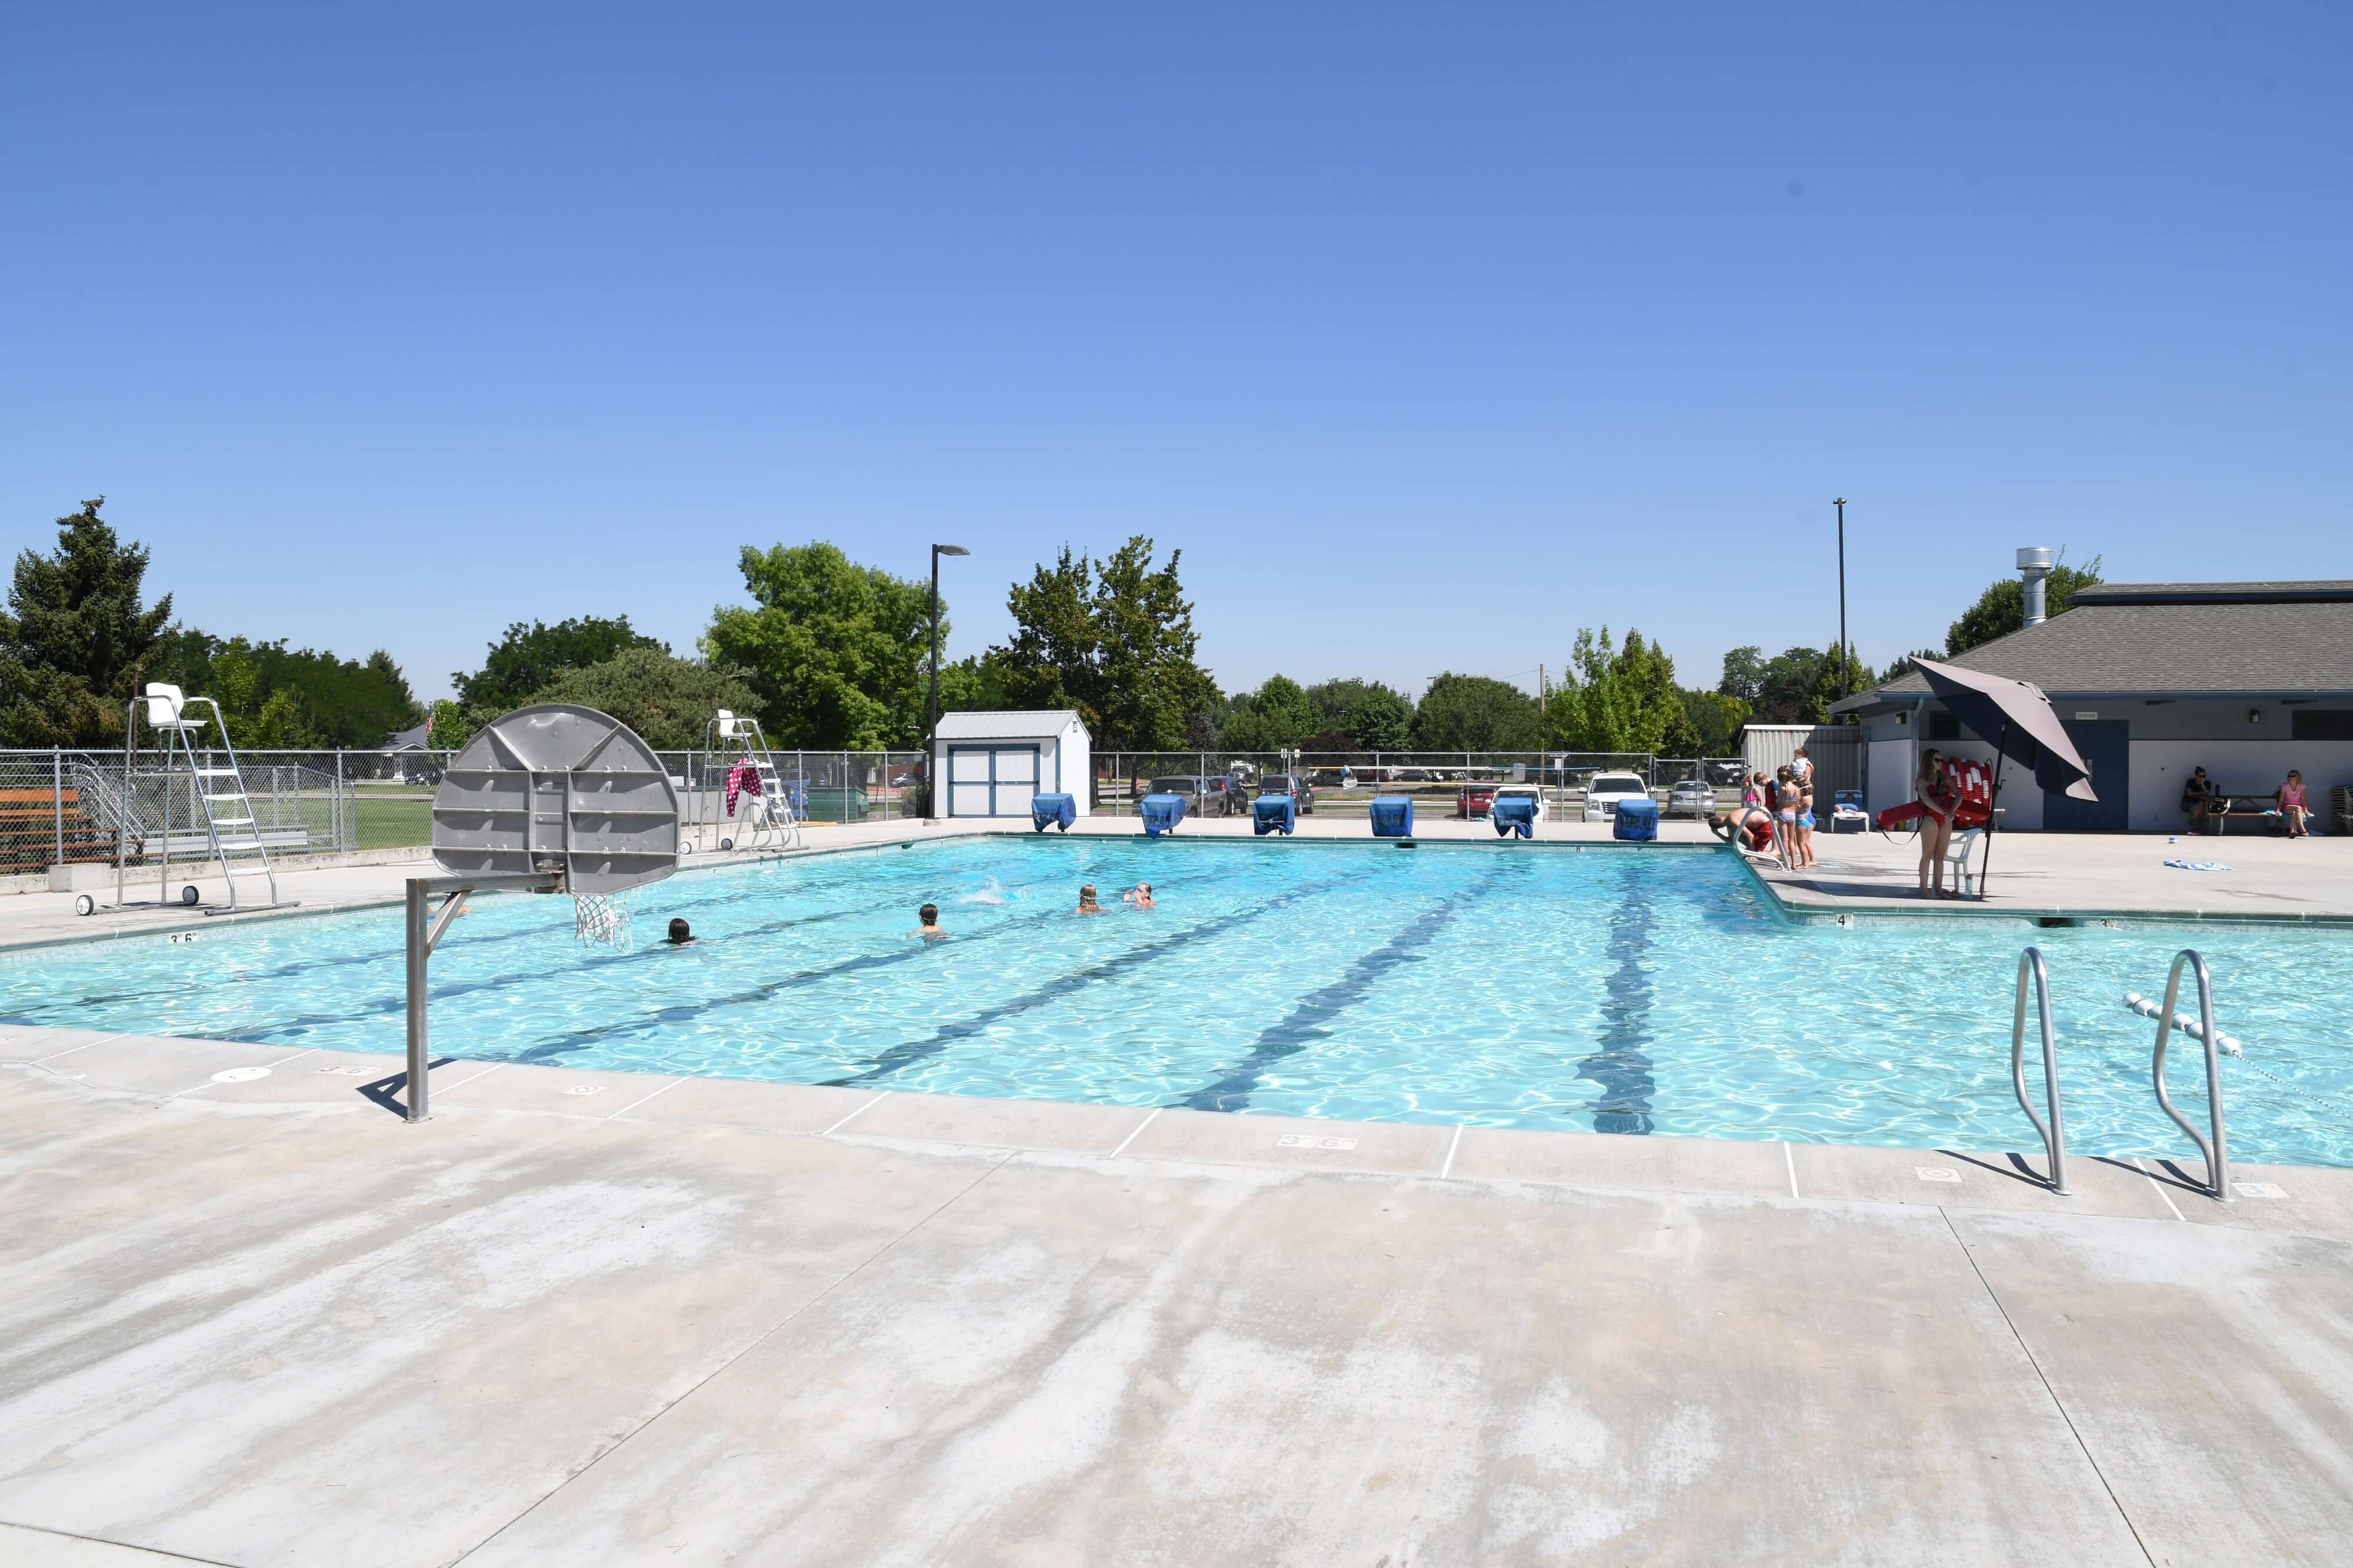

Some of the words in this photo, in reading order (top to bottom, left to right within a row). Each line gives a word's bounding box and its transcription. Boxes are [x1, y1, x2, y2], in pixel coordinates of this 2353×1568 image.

[1838, 915, 1845, 926] 4
[185, 933, 192, 942] 6
[1281, 1136, 1299, 1145] 3
[1321, 1138, 1340, 1147] 6
